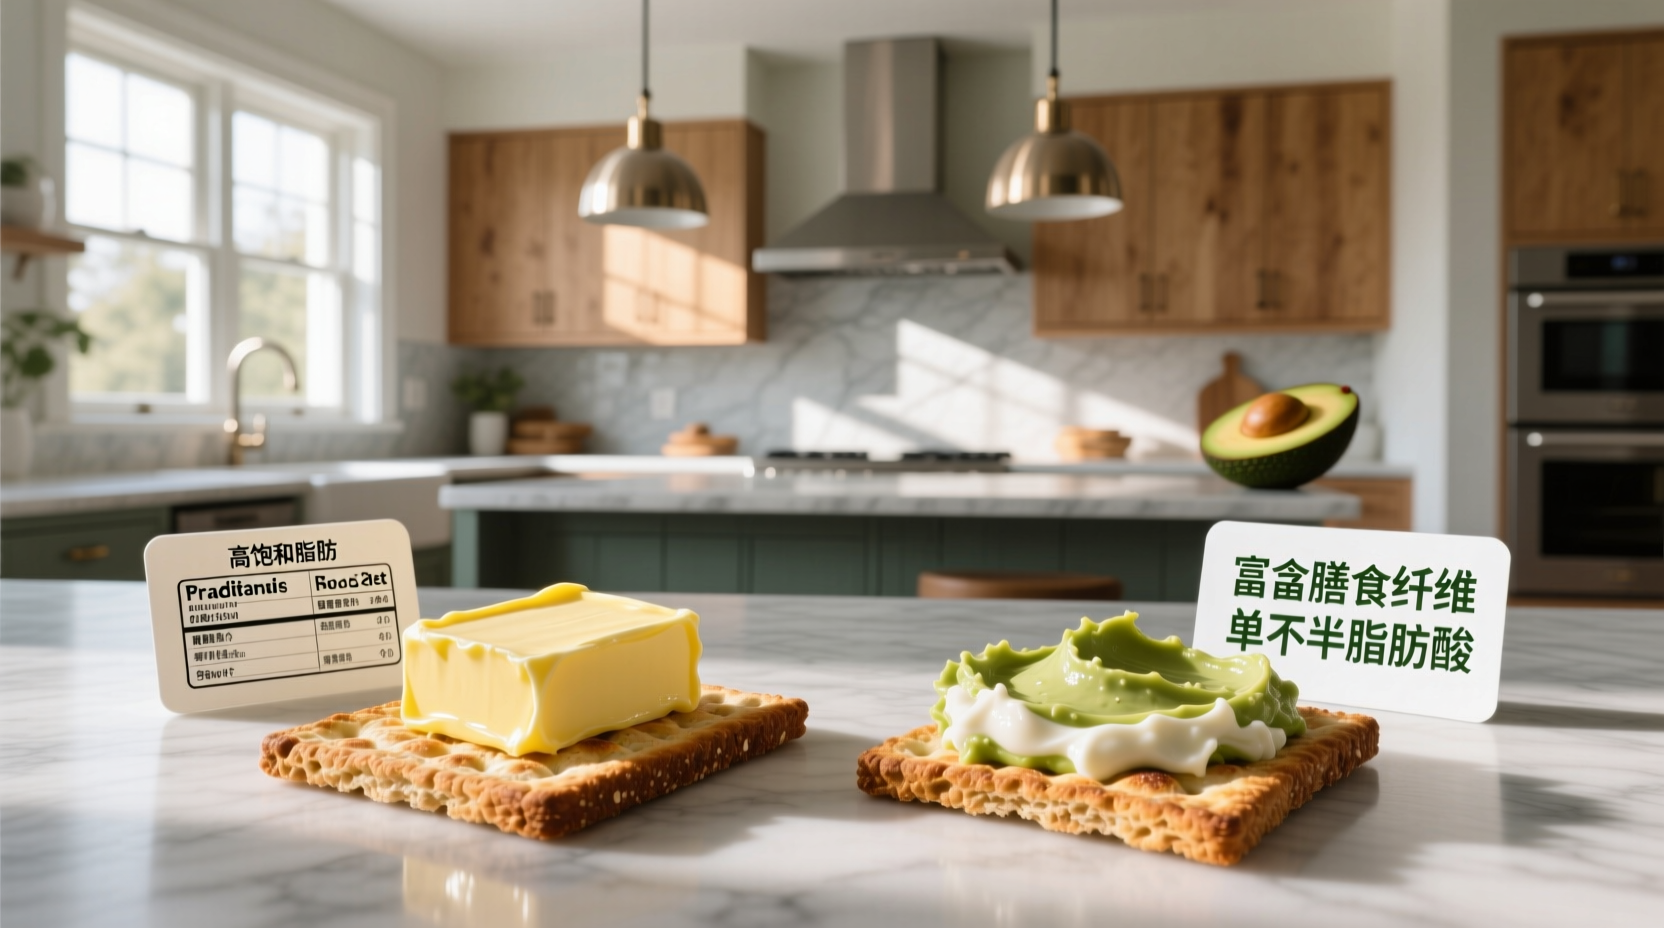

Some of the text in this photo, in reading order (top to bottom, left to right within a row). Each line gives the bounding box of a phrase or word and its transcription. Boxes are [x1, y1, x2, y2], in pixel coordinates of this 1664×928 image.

[228, 539, 337, 569] 高饱和脂肪
[1226, 607, 1475, 674] 单不半脂肪酸
